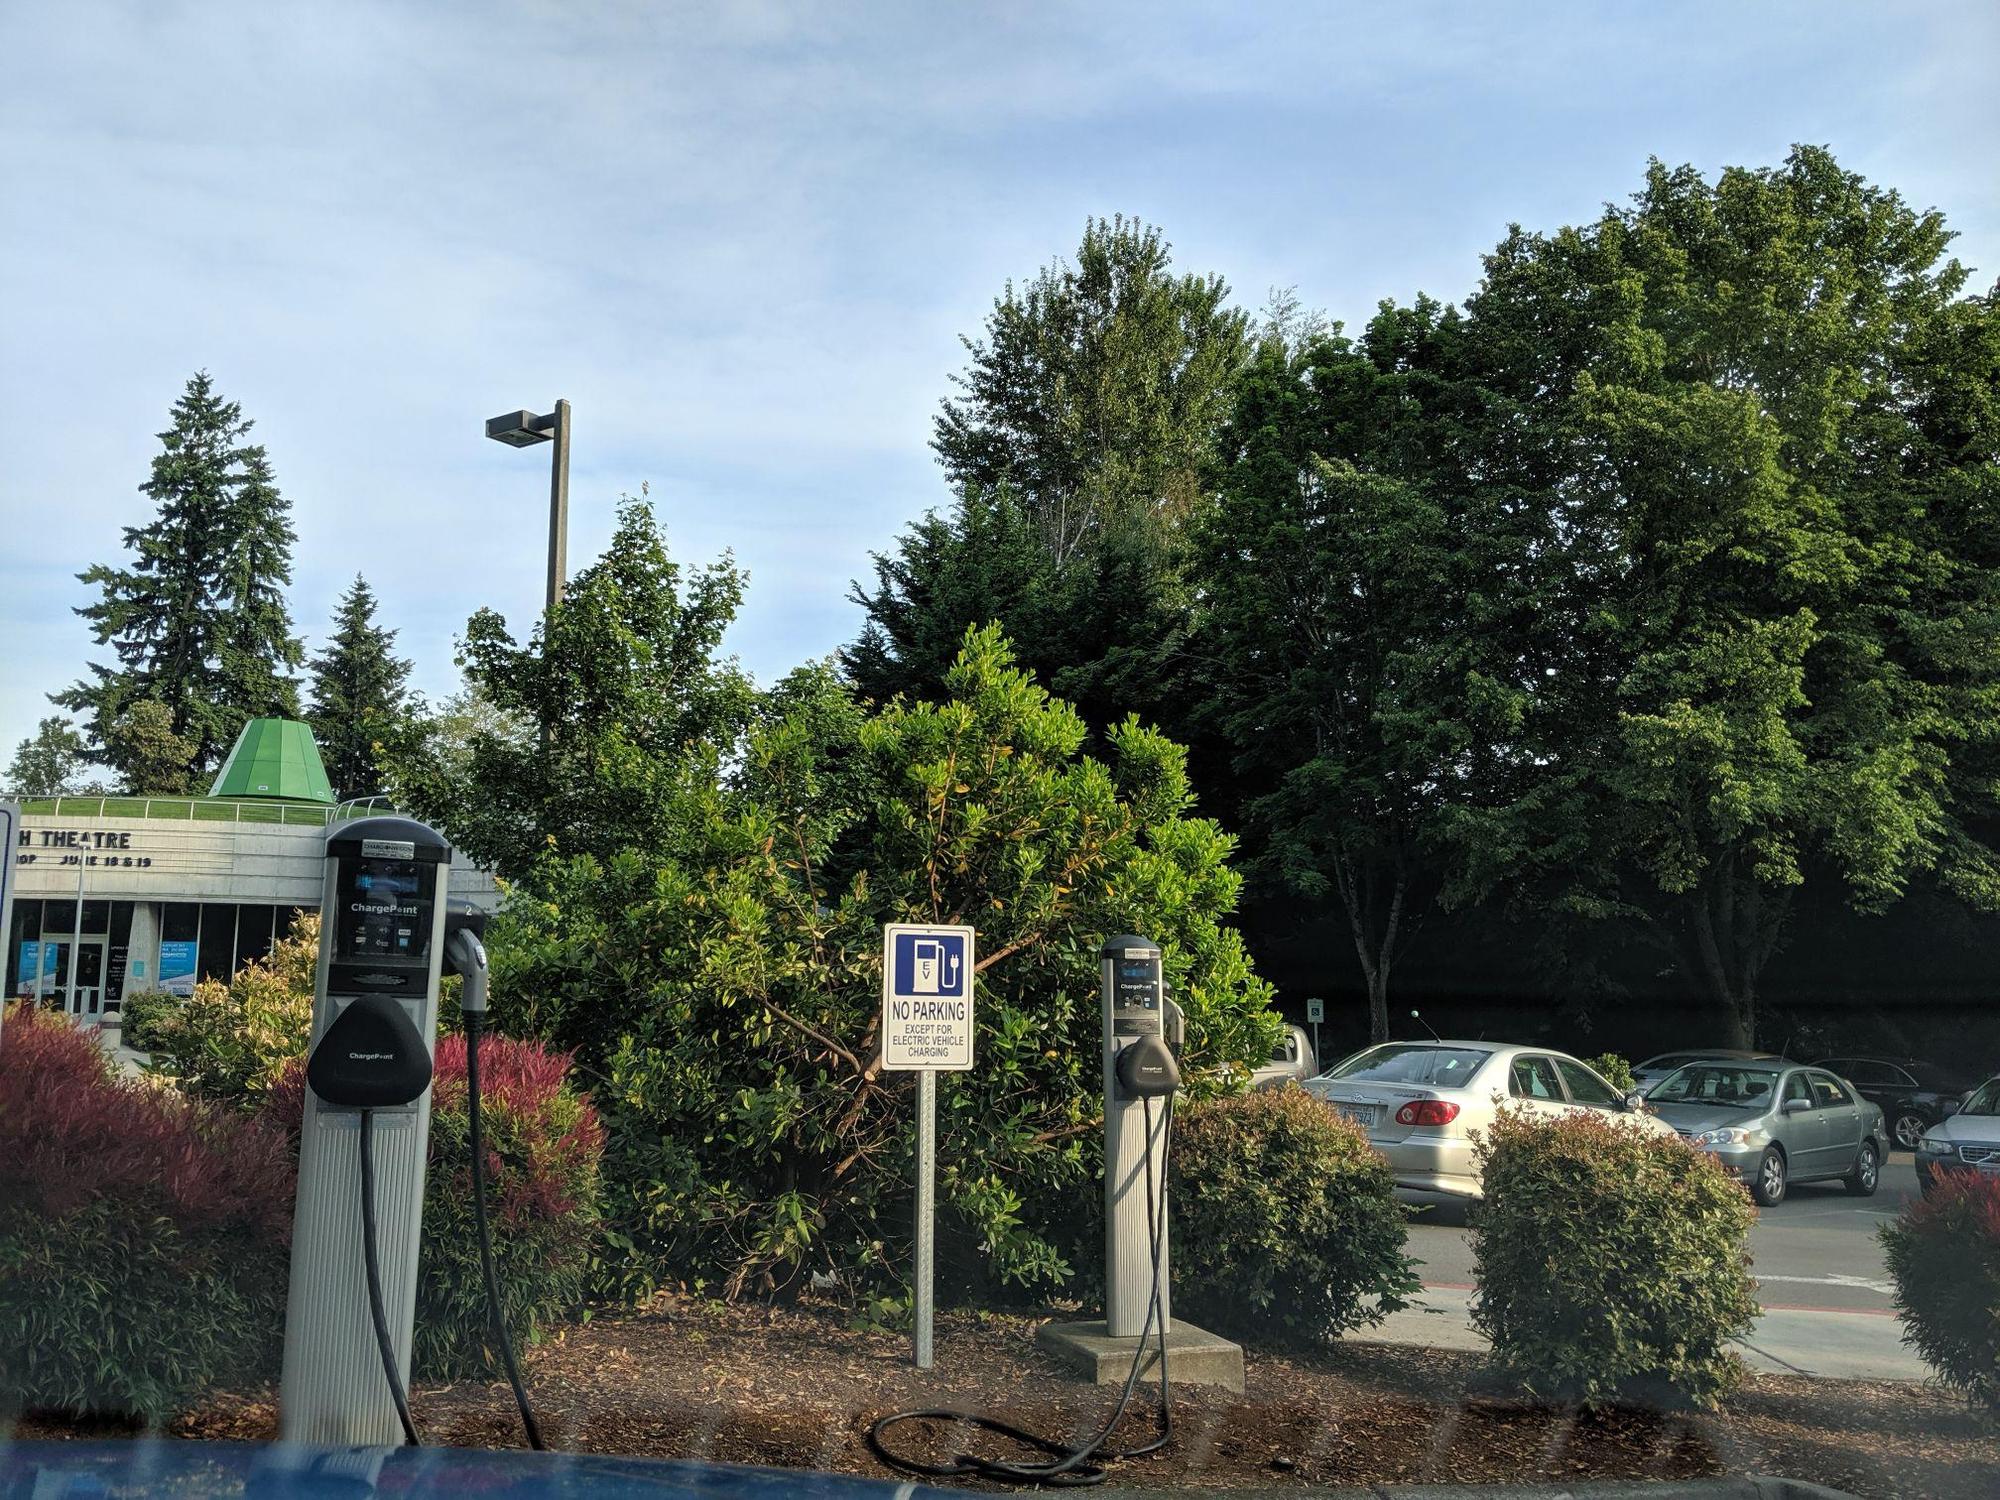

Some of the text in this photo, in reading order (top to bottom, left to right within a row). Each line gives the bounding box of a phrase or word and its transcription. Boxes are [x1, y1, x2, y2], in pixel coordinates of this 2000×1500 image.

[41, 831, 131, 849] THEATRE
[104, 856, 119, 867] 18
[137, 857, 152, 868] 19
[351, 903, 418, 915] ChargePoint
[465, 904, 473, 916] 2
[893, 1001, 965, 1021] NO PARKING
[905, 1024, 953, 1034] EXCEPT FOR
[892, 1035, 964, 1046] ELECTRIC VEHICLE
[349, 1052, 393, 1060] ChargePoint
[908, 1047, 949, 1057] CHARGING
